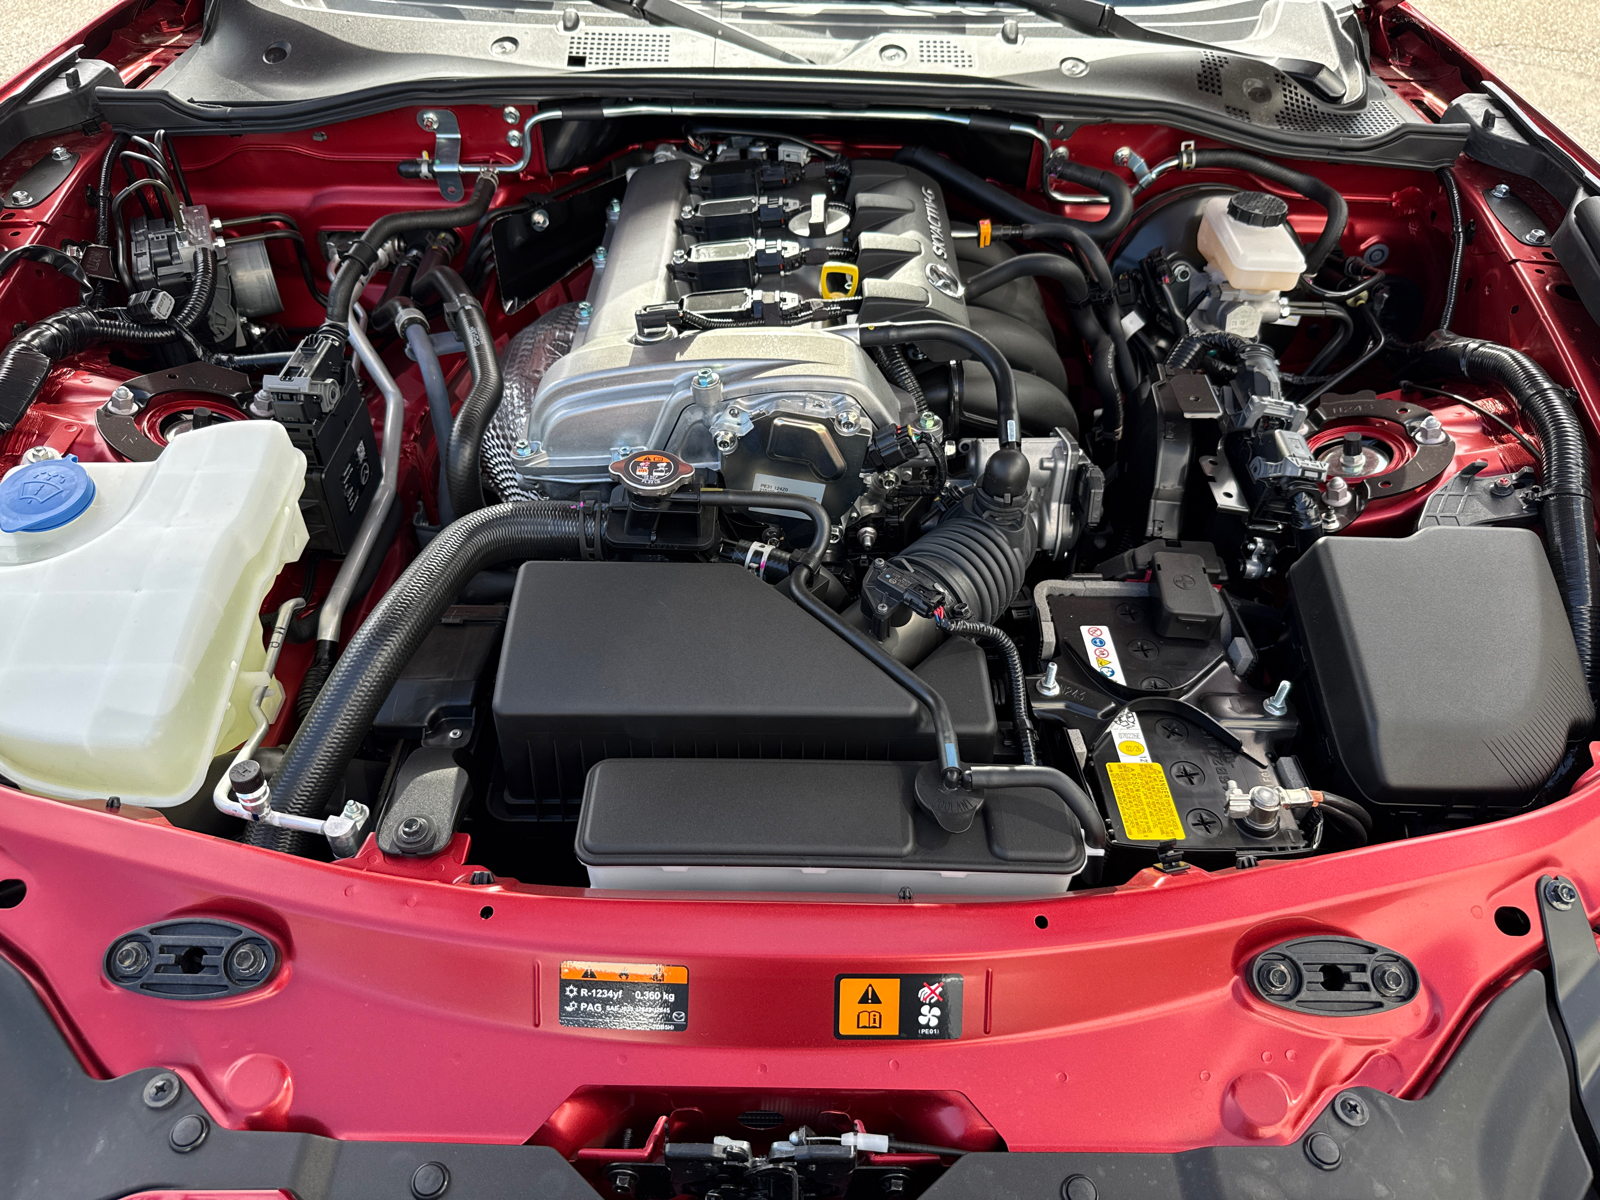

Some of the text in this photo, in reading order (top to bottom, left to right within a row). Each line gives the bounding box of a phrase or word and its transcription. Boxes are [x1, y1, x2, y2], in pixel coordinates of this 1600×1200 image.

[1129, 774, 1141, 792] POISON
[1157, 776, 1170, 798] DANGER
[932, 798, 974, 813] COOLANT
[580, 988, 675, 1002] R-1234yf 0.360 kg
[580, 1003, 602, 1012] PAG
